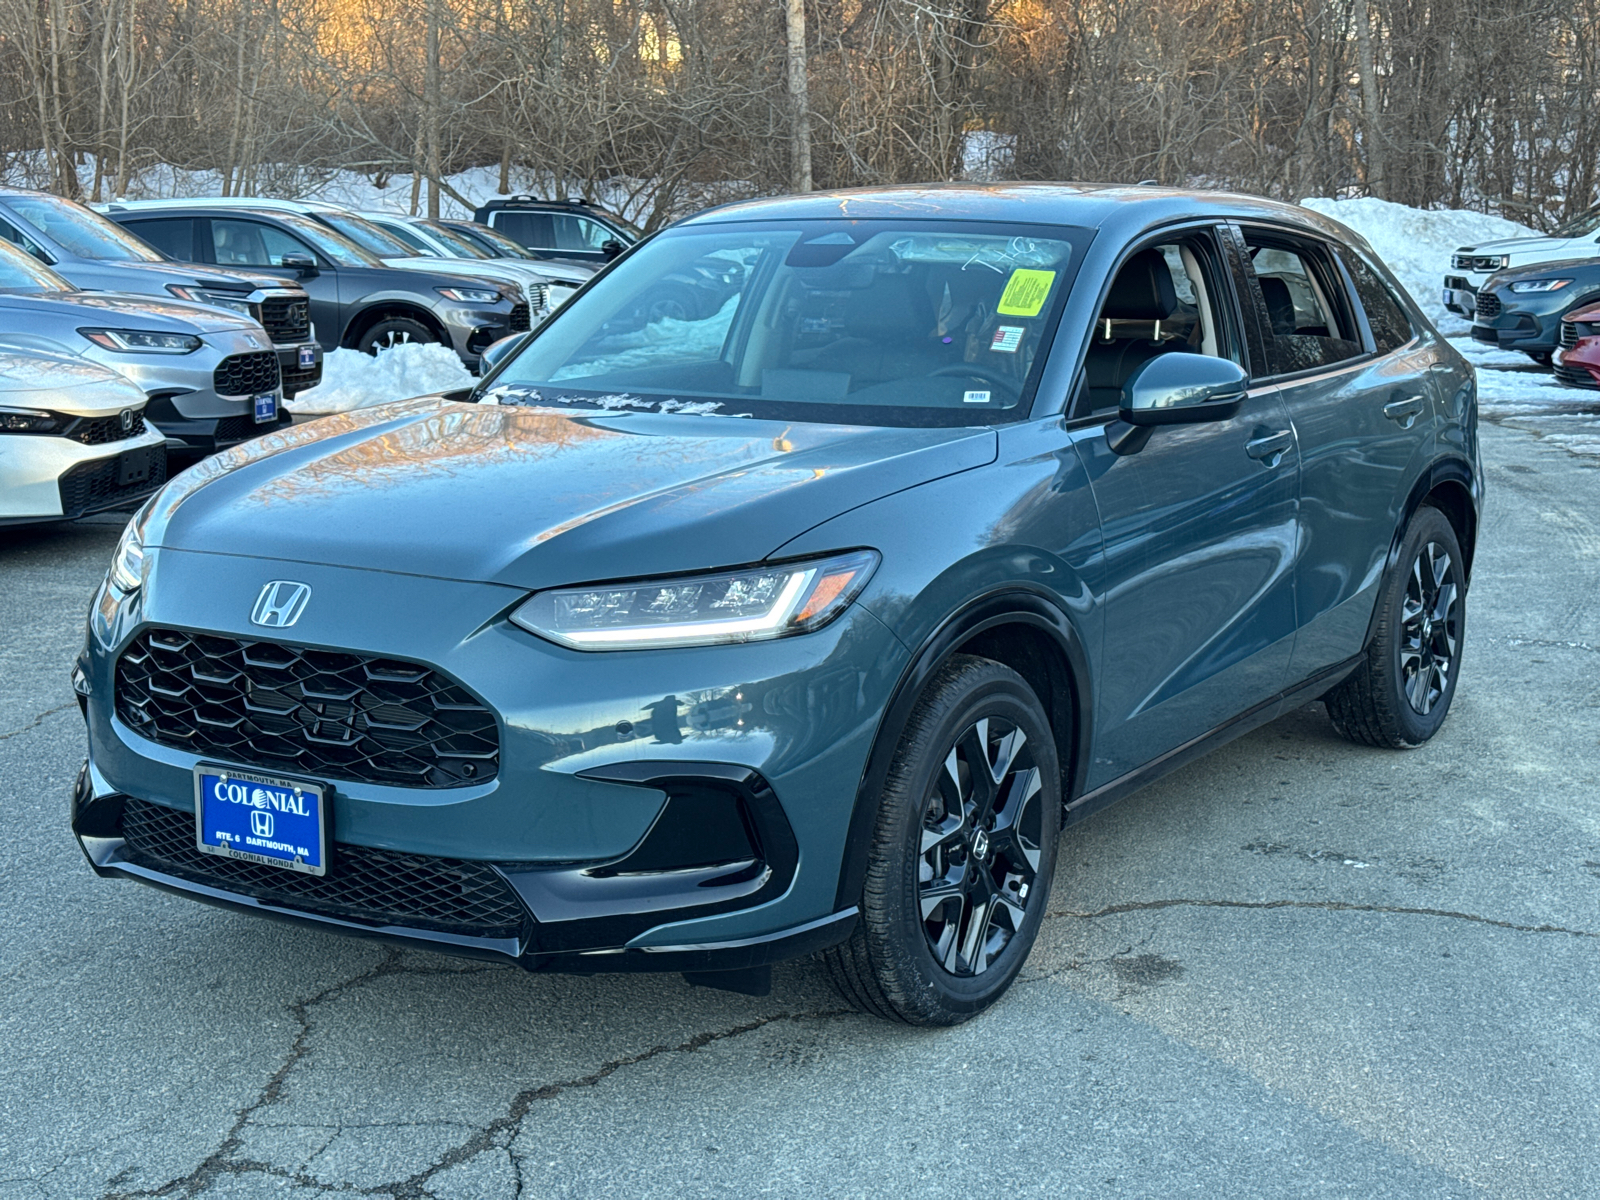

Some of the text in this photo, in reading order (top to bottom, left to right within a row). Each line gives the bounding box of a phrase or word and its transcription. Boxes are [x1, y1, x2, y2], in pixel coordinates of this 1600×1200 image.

[280, 780, 292, 788] MA
[214, 782, 310, 816] COLONIAL
[235, 834, 240, 842] 6
[246, 836, 295, 854] DARTMOUTH,
[297, 847, 309, 856] MA
[228, 850, 295, 869] COLONIAL HONDA
